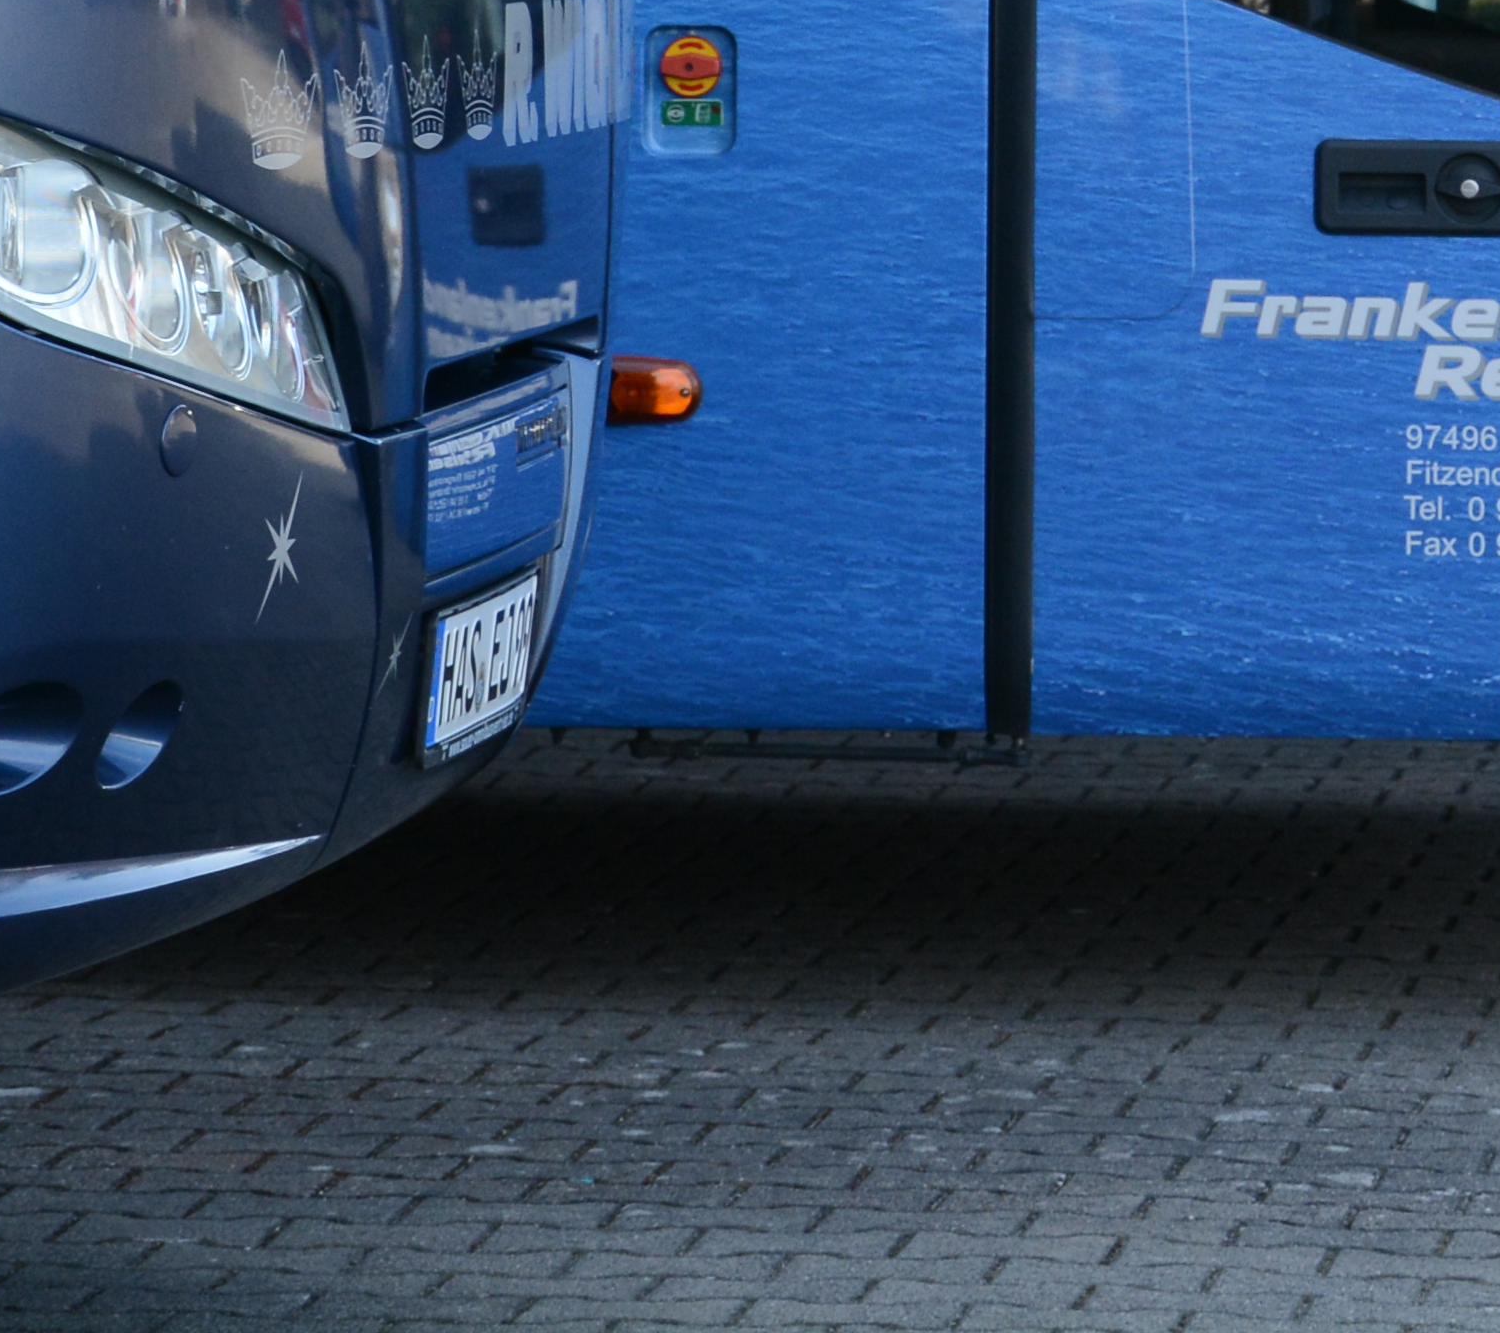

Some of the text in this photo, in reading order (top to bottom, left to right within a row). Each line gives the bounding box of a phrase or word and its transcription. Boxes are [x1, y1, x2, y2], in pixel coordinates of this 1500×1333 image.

[1405, 425, 1498, 451] 97496
[1403, 495, 1451, 521] Tel.
[1467, 496, 1485, 522] 0
[1404, 531, 1457, 556] Fax
[1468, 532, 1486, 558] 0
[438, 619, 481, 727] HAS
